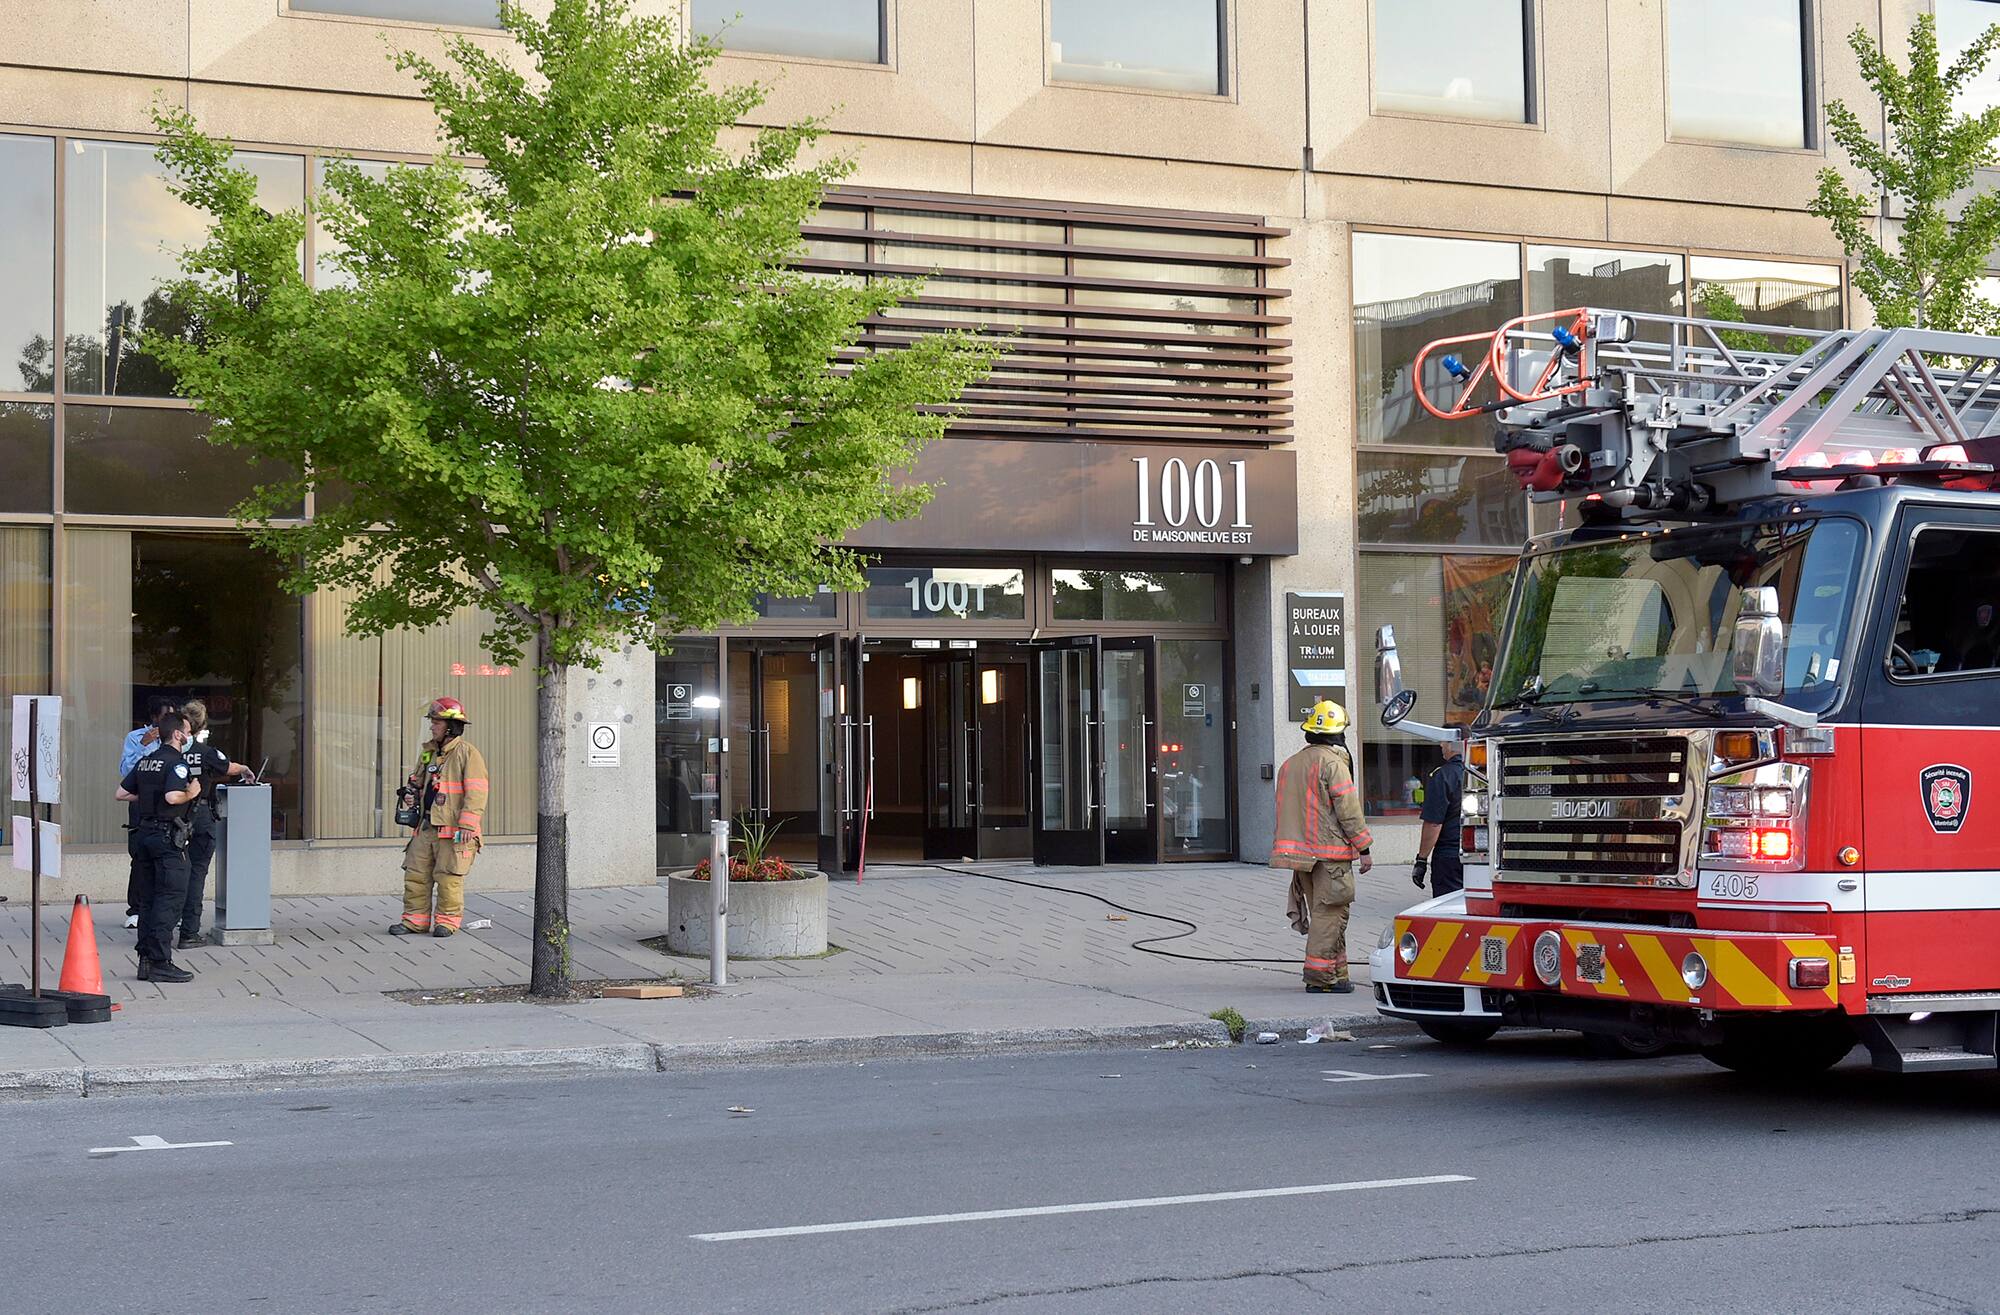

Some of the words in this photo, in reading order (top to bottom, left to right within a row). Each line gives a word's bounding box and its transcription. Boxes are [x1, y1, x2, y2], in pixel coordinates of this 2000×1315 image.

[1131, 457, 1252, 528] 1001
[1133, 530, 1148, 541] DE
[1152, 530, 1229, 543] MAISONNEUVE
[1231, 532, 1252, 544] EST
[905, 577, 984, 613] 1001
[1292, 608, 1340, 620] BUREAUX
[1292, 621, 1301, 636] À
[1304, 624, 1341, 636] LOUER
[1316, 715, 1323, 726] 5
[137, 760, 164, 772] POLICE
[1711, 874, 1759, 898] 405
